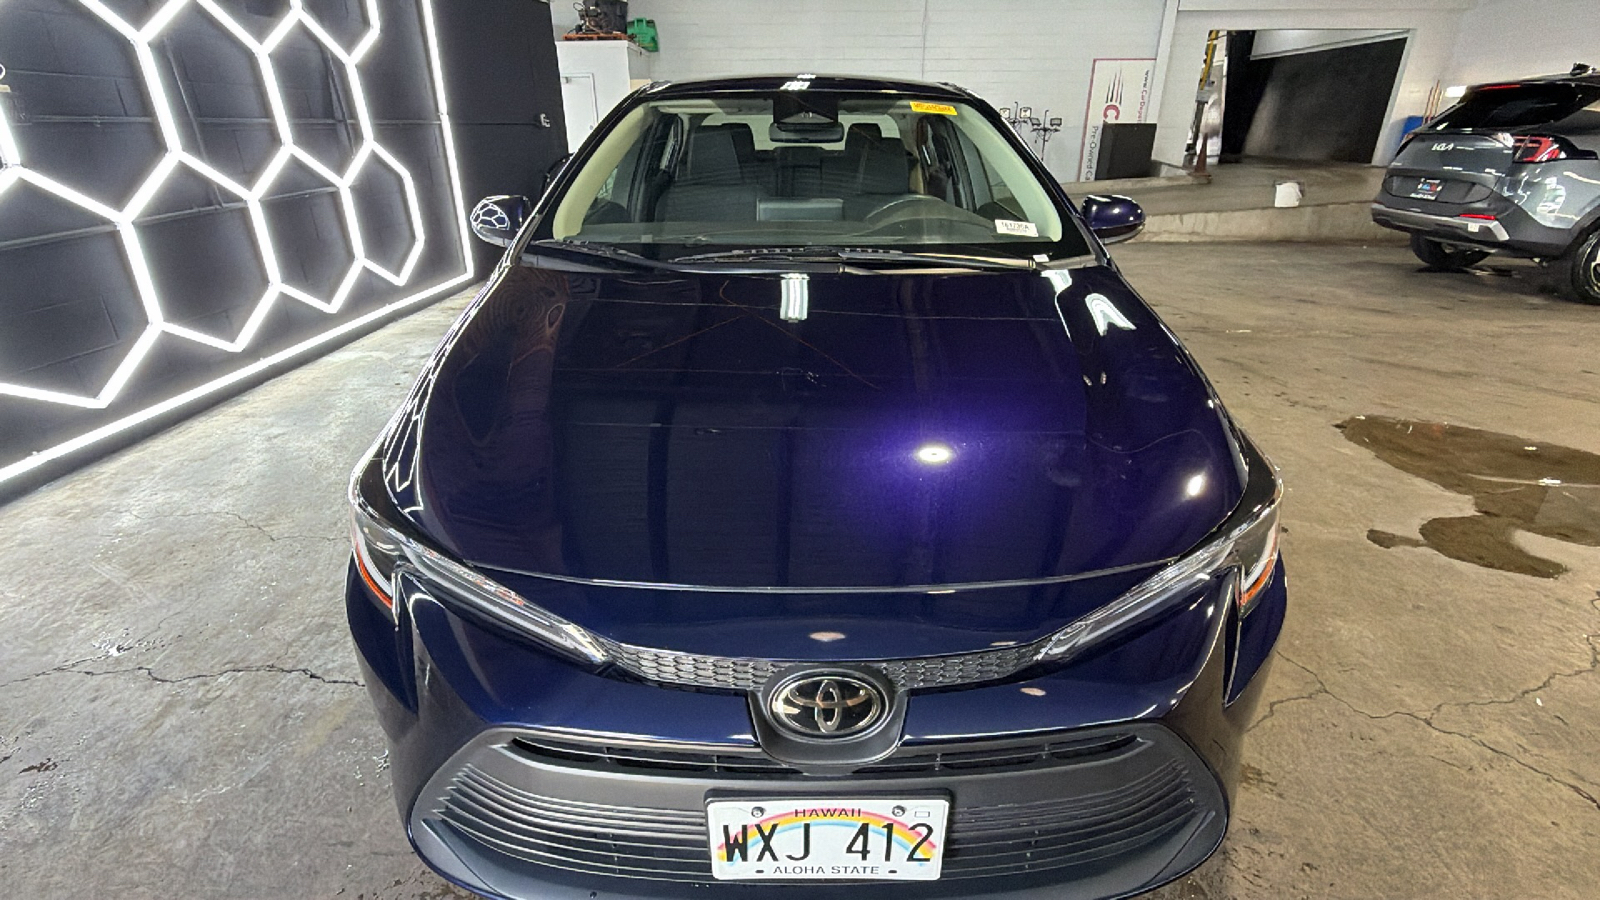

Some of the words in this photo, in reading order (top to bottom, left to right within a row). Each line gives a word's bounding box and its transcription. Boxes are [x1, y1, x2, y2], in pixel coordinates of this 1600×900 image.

[1102, 104, 1121, 122] C
[1086, 125, 1099, 170] Pre-Owned
[1431, 142, 1454, 151] KIA
[794, 808, 862, 818] HAWAII
[722, 822, 812, 863] WXJ
[846, 822, 934, 863] 412
[773, 865, 826, 875] ALOHA
[831, 865, 880, 875] STATE
